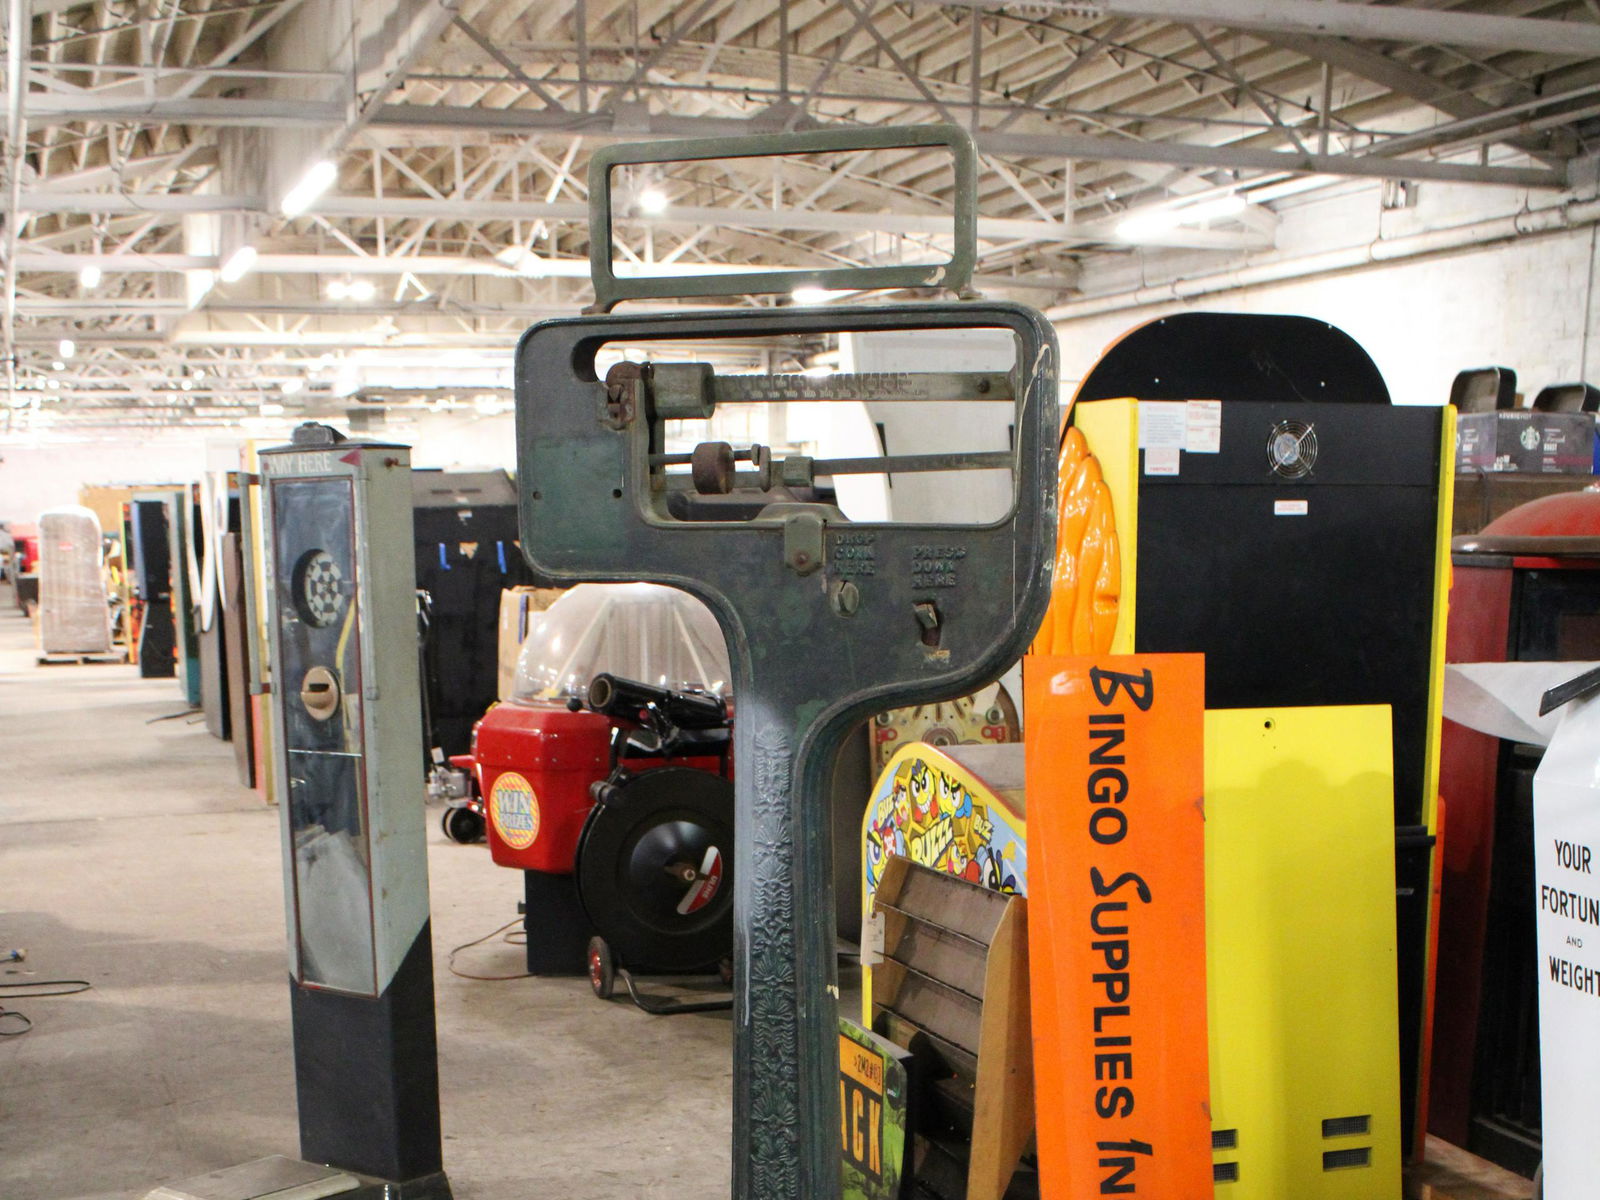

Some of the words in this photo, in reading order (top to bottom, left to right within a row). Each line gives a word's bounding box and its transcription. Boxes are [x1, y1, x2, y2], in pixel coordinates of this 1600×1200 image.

[298, 452, 332, 473] HERE
[497, 790, 531, 814] WIN
[1554, 839, 1591, 875] YOUR
[1566, 935, 1583, 949] AND
